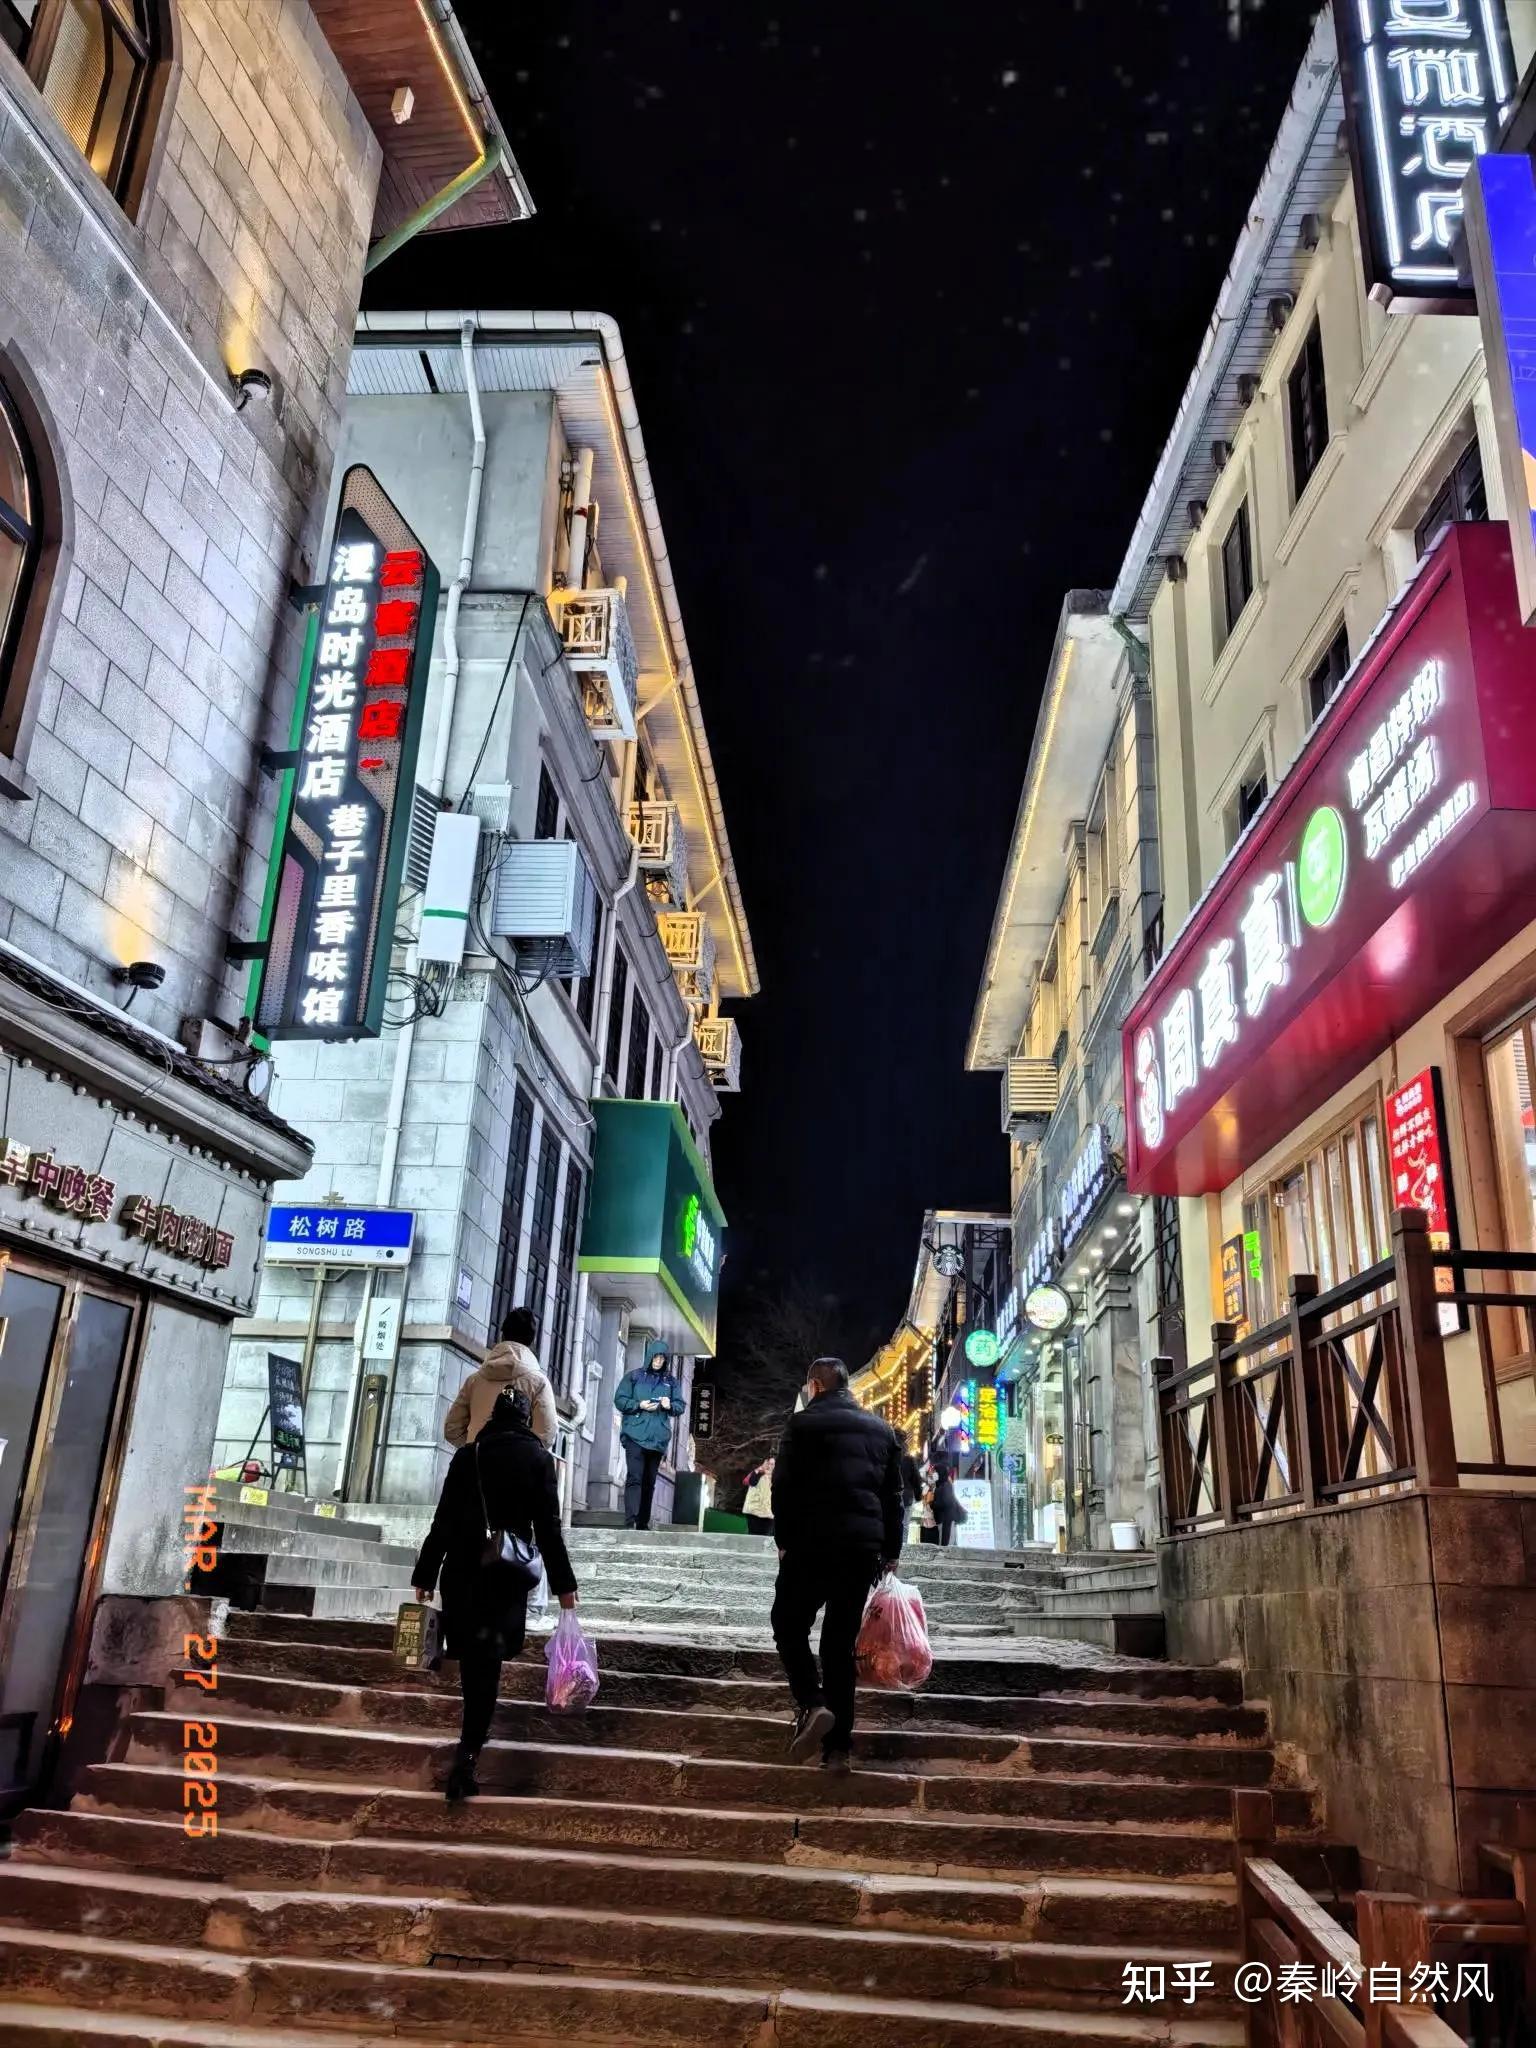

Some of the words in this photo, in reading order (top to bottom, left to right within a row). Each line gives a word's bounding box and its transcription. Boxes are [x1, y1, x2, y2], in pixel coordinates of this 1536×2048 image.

[301, 803, 367, 1024] 巷子里香味馆
[0, 1138, 117, 1222] 早中晚餐
[288, 1215, 367, 1240] 松树路
[297, 1247, 337, 1256] SONGSHU
[341, 1249, 353, 1257] LU
